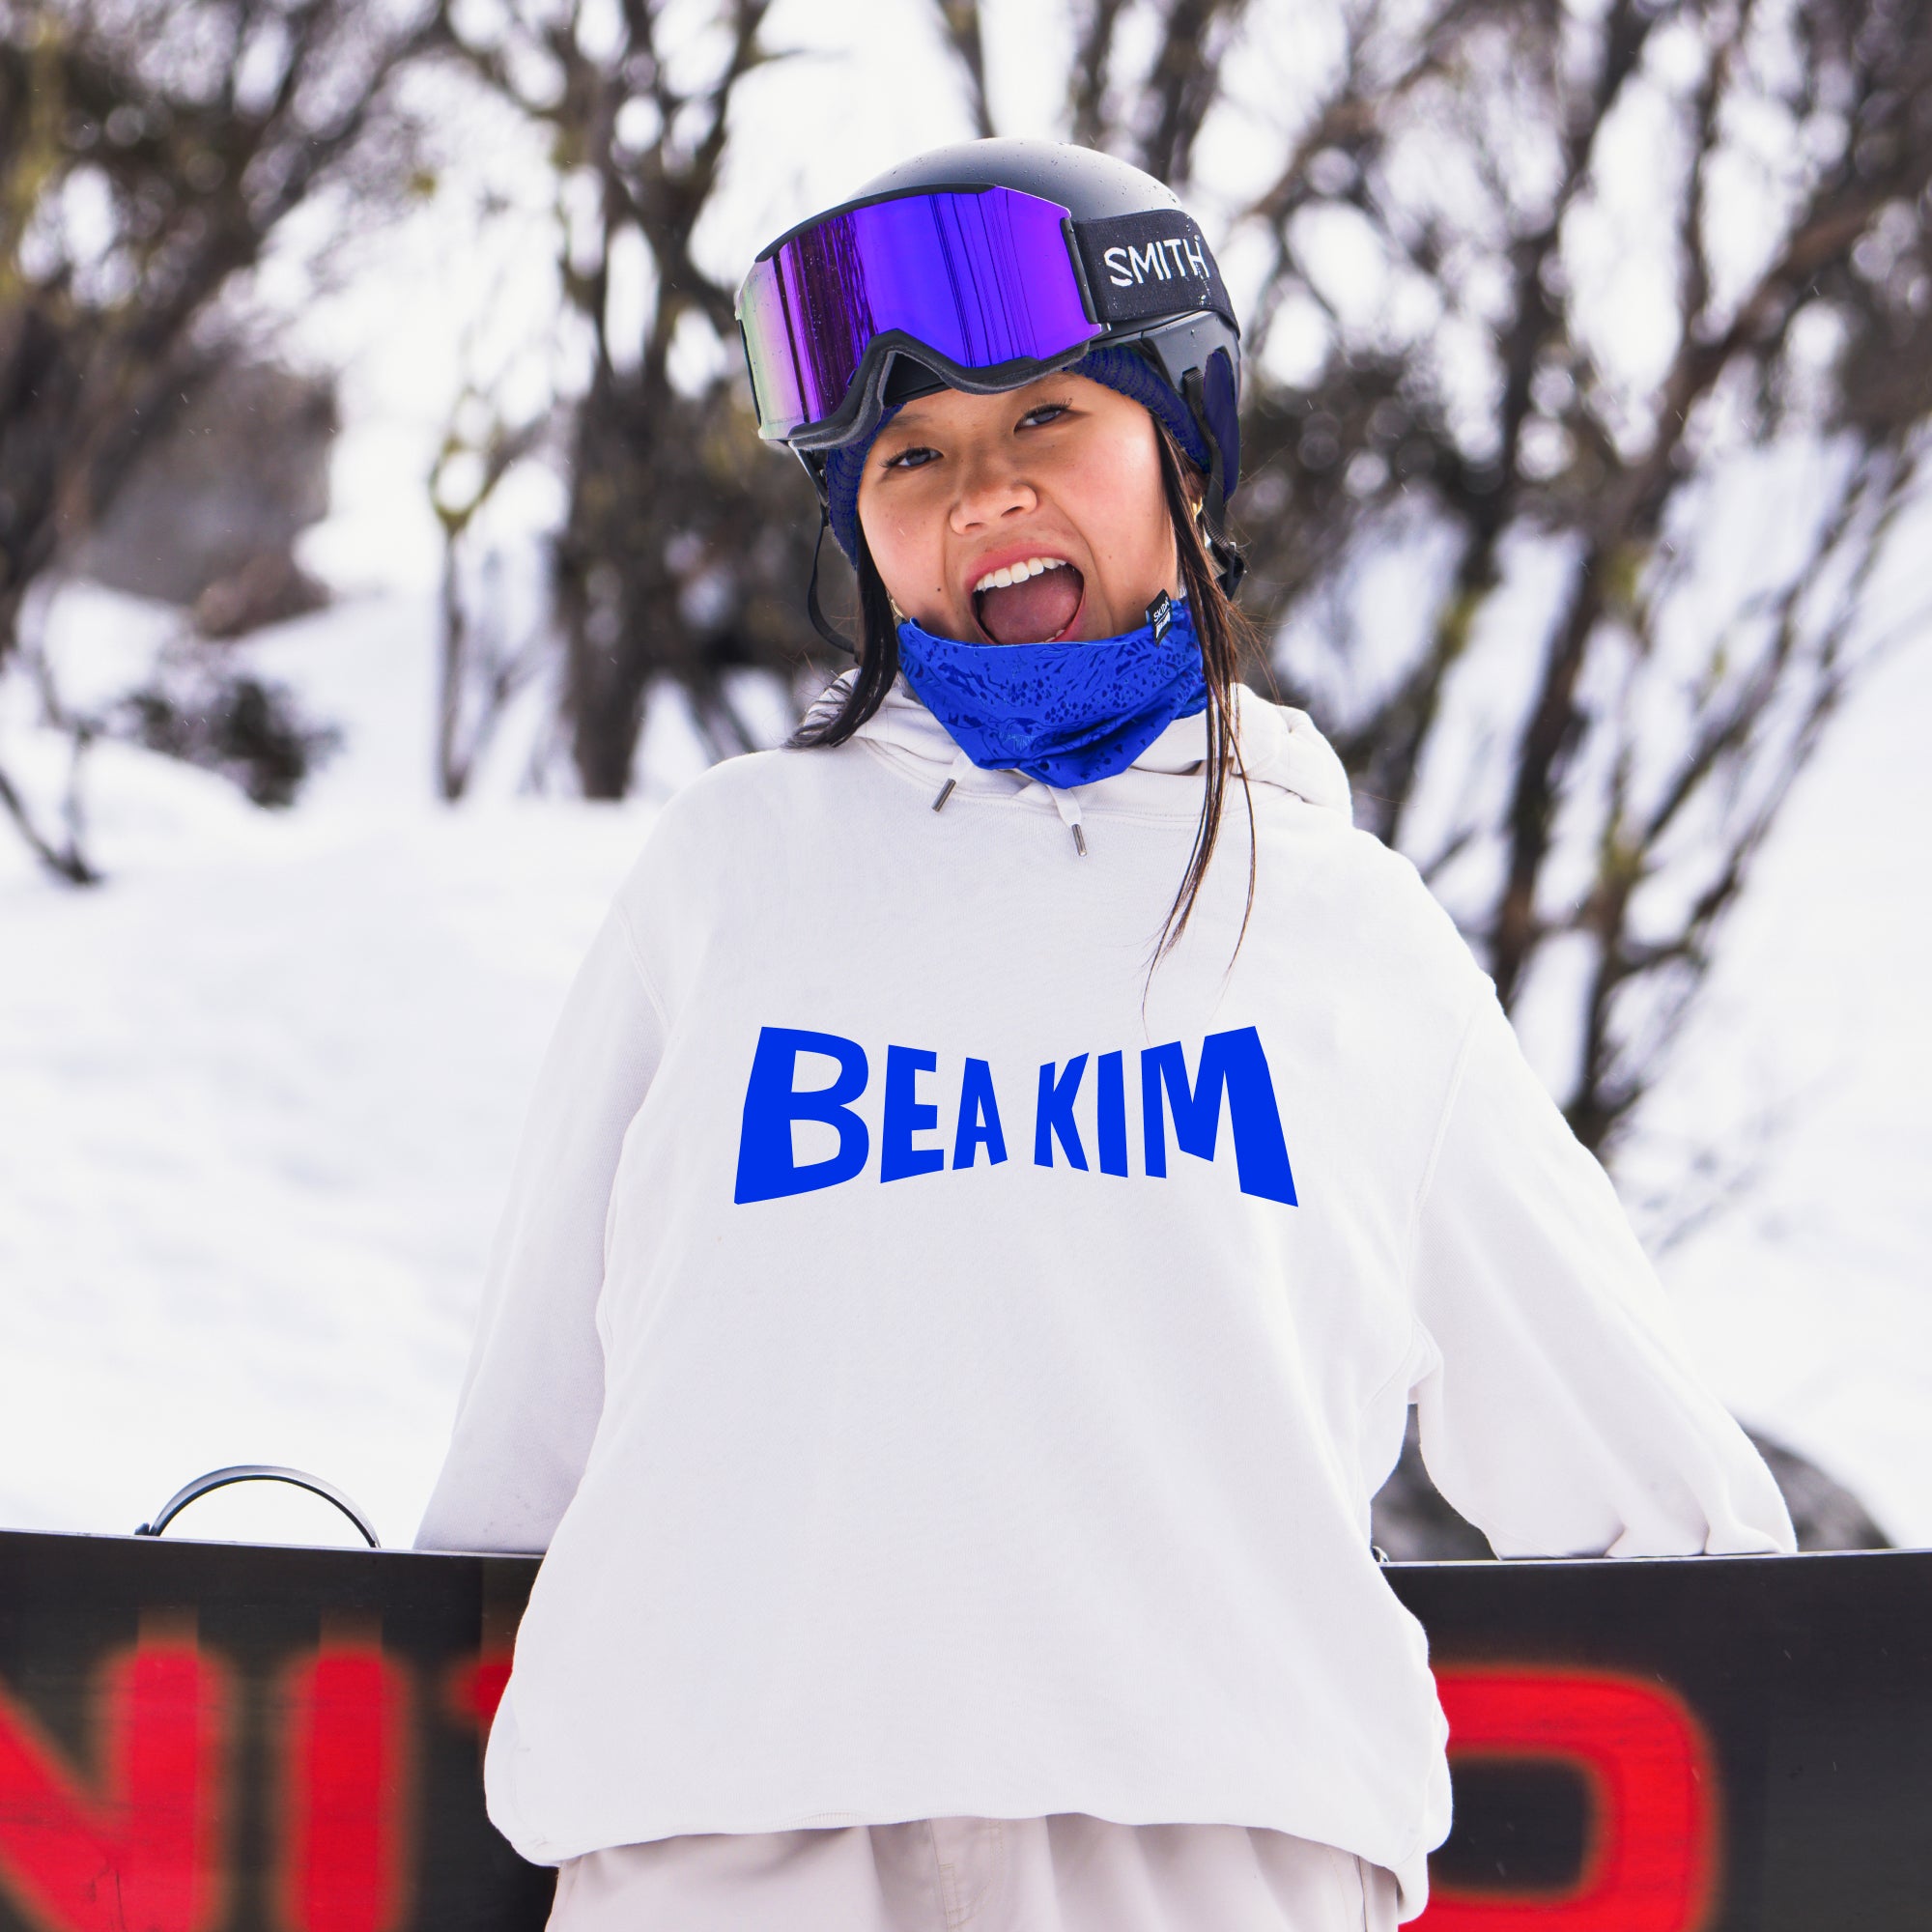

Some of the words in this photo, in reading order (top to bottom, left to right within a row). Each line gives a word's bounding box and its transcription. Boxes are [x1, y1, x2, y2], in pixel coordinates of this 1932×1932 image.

[1103, 238, 1210, 287] SMITH
[734, 1027, 1008, 1205] BEA
[1035, 1026, 1299, 1208] KIM
